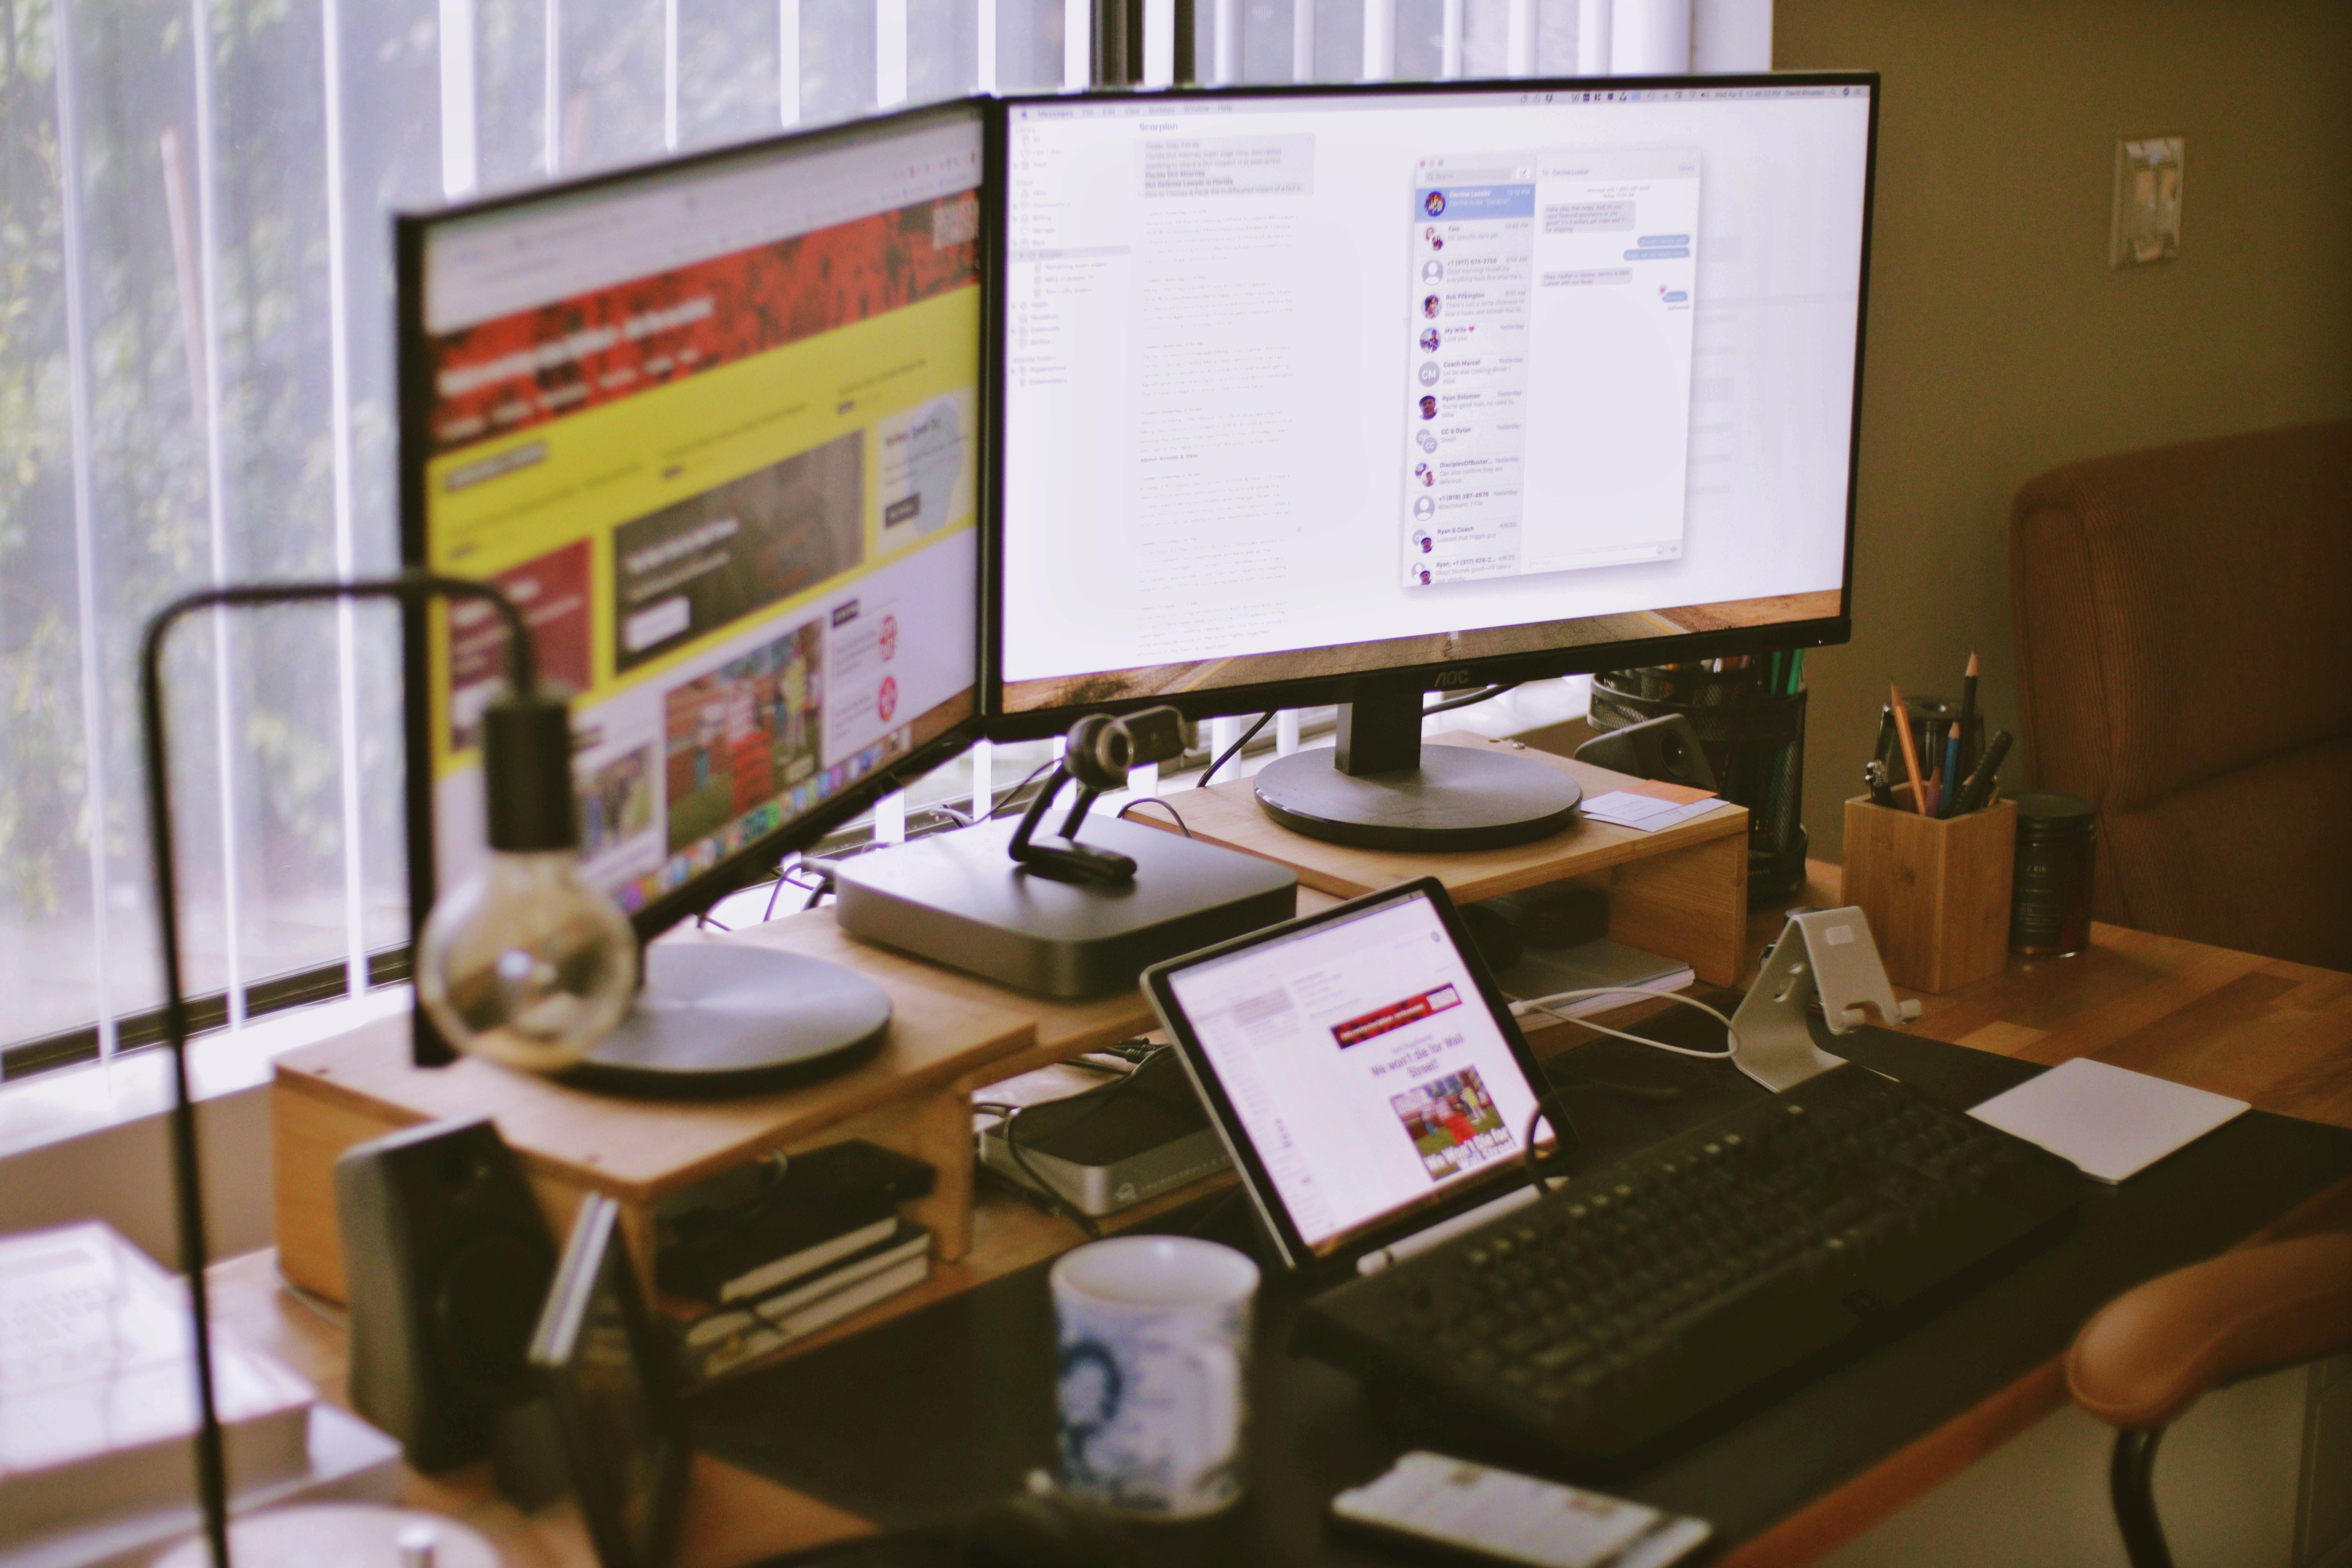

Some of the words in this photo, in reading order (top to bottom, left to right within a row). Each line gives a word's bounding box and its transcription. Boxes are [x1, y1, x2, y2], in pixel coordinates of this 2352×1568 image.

[1139, 122, 1178, 132] Scorpion
[1500, 323, 1524, 332] Yesterday
[1422, 370, 1436, 379] CM
[1497, 390, 1522, 398] Yesterday
[1496, 423, 1521, 431] Yesterday
[1439, 458, 1493, 469] DisciplesOfBuster...
[1495, 456, 1519, 464] Yesterday
[1446, 493, 1461, 501] (818)
[1494, 488, 1517, 497] Yesterday
[1438, 501, 1469, 510] Attachment:
[1499, 521, 1516, 530] 4/6/20
[1437, 527, 1451, 535] Ryan
[1469, 533, 1486, 541] friggin
[1498, 554, 1515, 563] 4/6/20
[1436, 560, 1451, 569] Ryan,
[1460, 558, 1474, 566] (317)
[1434, 670, 1468, 687] AOC
[1370, 1065, 1386, 1076] We
[1414, 1049, 1428, 1060] die
[1428, 1043, 1442, 1054] for
[1443, 1033, 1465, 1047] Wall
